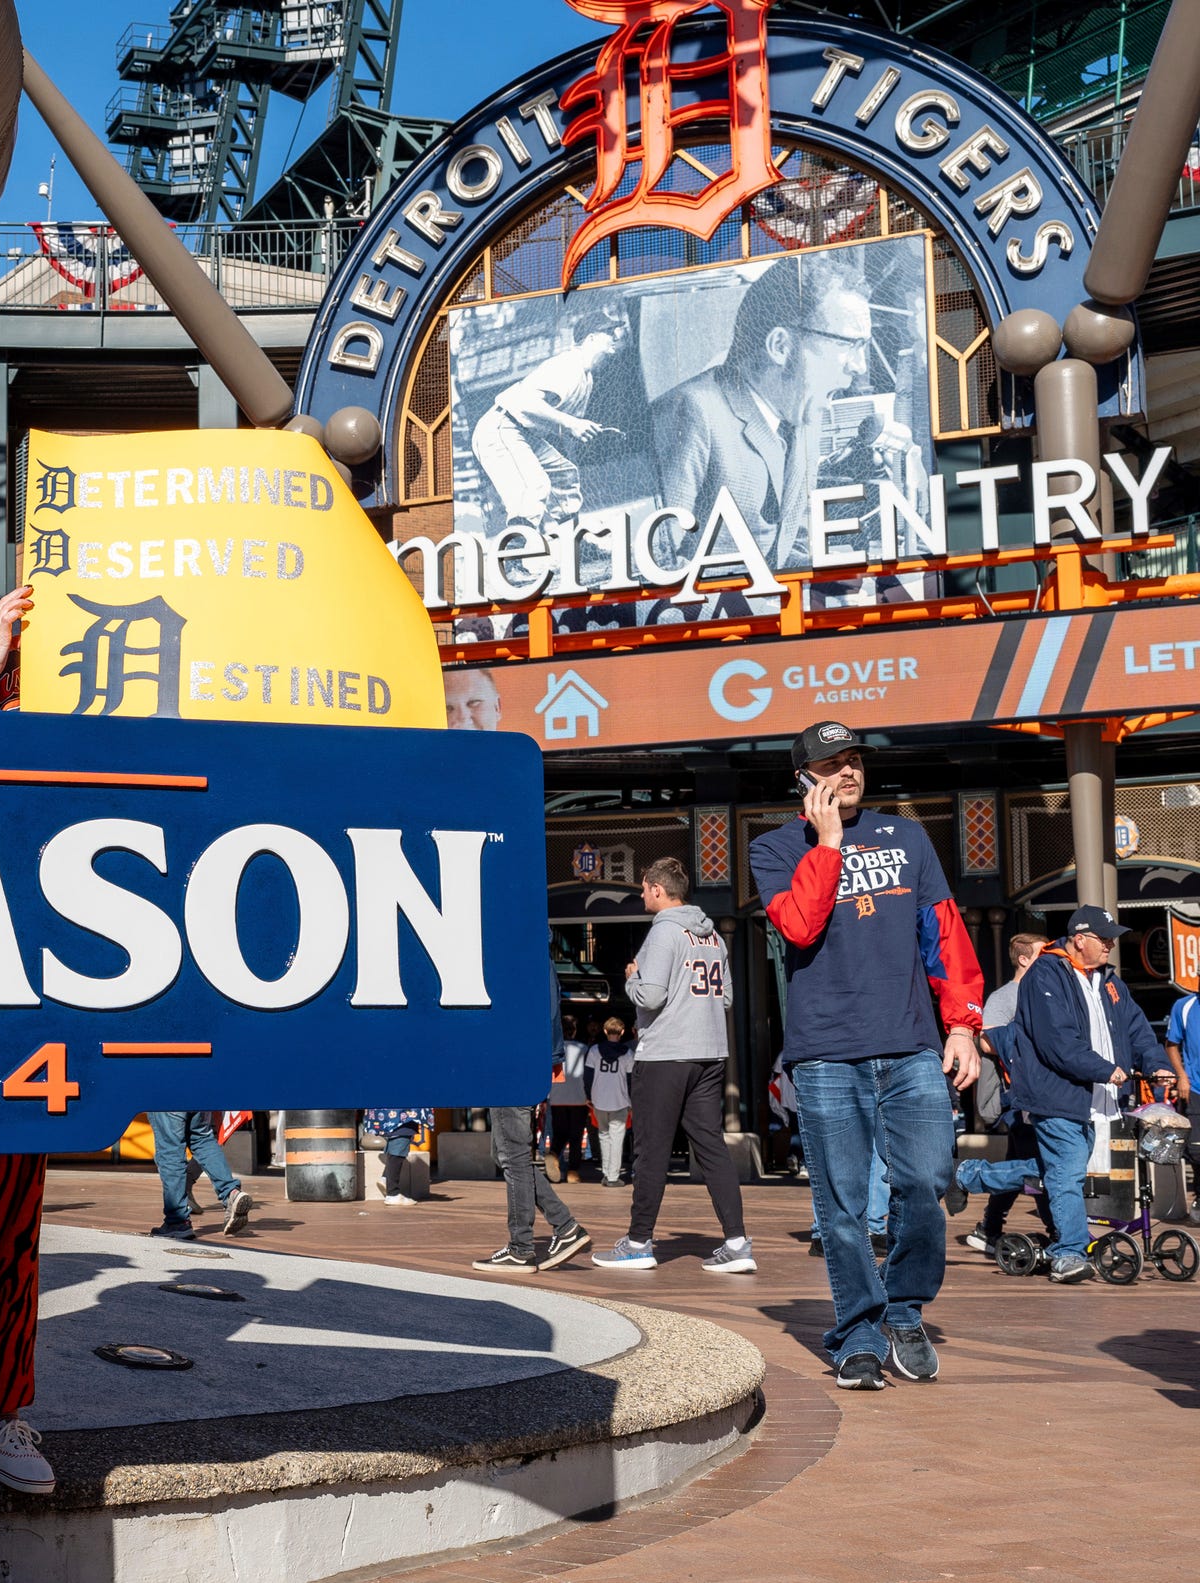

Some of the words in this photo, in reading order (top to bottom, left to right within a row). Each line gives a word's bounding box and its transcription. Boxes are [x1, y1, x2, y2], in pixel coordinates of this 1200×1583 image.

[327, 88, 560, 374] DETROIT
[811, 46, 1075, 273] TIGERS
[34, 458, 335, 514] DETERMINED
[811, 446, 1172, 567] ENTRY
[28, 524, 305, 580] DESERVED
[59, 593, 391, 718] DESTINED
[781, 656, 919, 689] GLOVER
[1124, 640, 1200, 675] LET
[814, 685, 888, 705] AGENCY
[837, 864, 902, 899] EADY
[1177, 933, 1200, 978] 19
